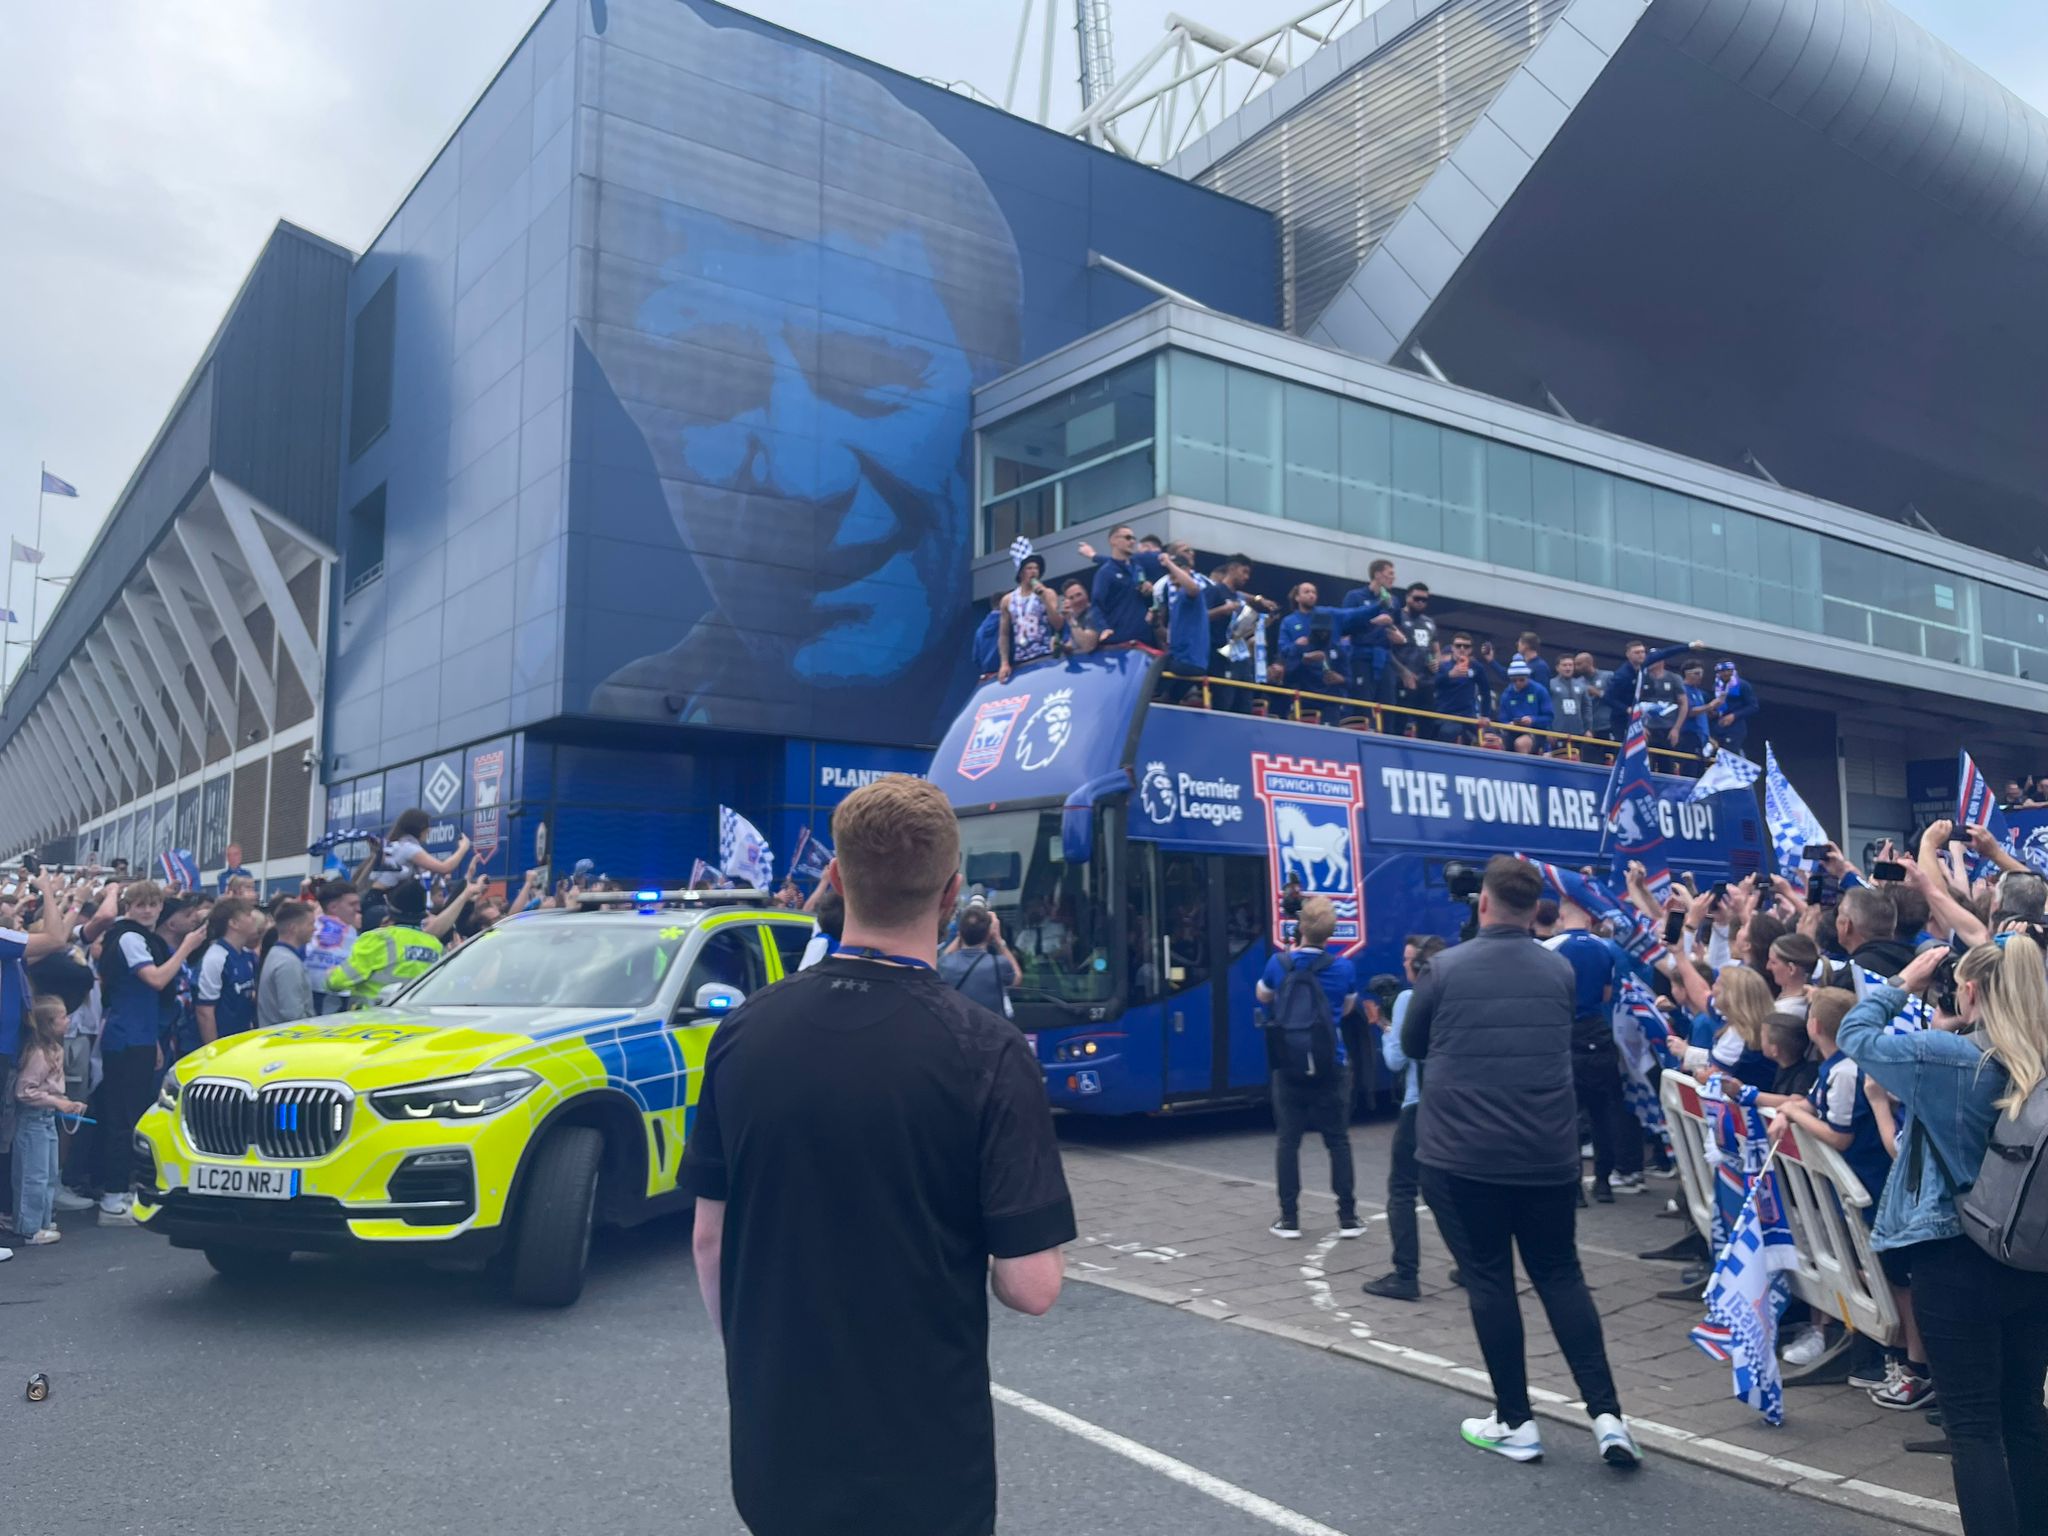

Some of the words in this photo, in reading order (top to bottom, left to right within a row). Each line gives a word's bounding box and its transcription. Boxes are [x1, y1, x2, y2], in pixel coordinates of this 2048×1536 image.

[821, 766, 891, 788] PLANE
[1177, 771, 1241, 800] Premier
[1268, 776, 1315, 792] IPSWICH
[1316, 781, 1350, 796] TOWN
[1179, 795, 1244, 827] League
[1381, 766, 1450, 819] THE
[1455, 774, 1541, 827] TOWN
[1549, 785, 1599, 832] ARE
[1676, 801, 1716, 842] UP!
[1088, 1007, 1106, 1020] 37
[196, 1167, 243, 1191] LC20
[247, 1171, 285, 1194] NRJ
